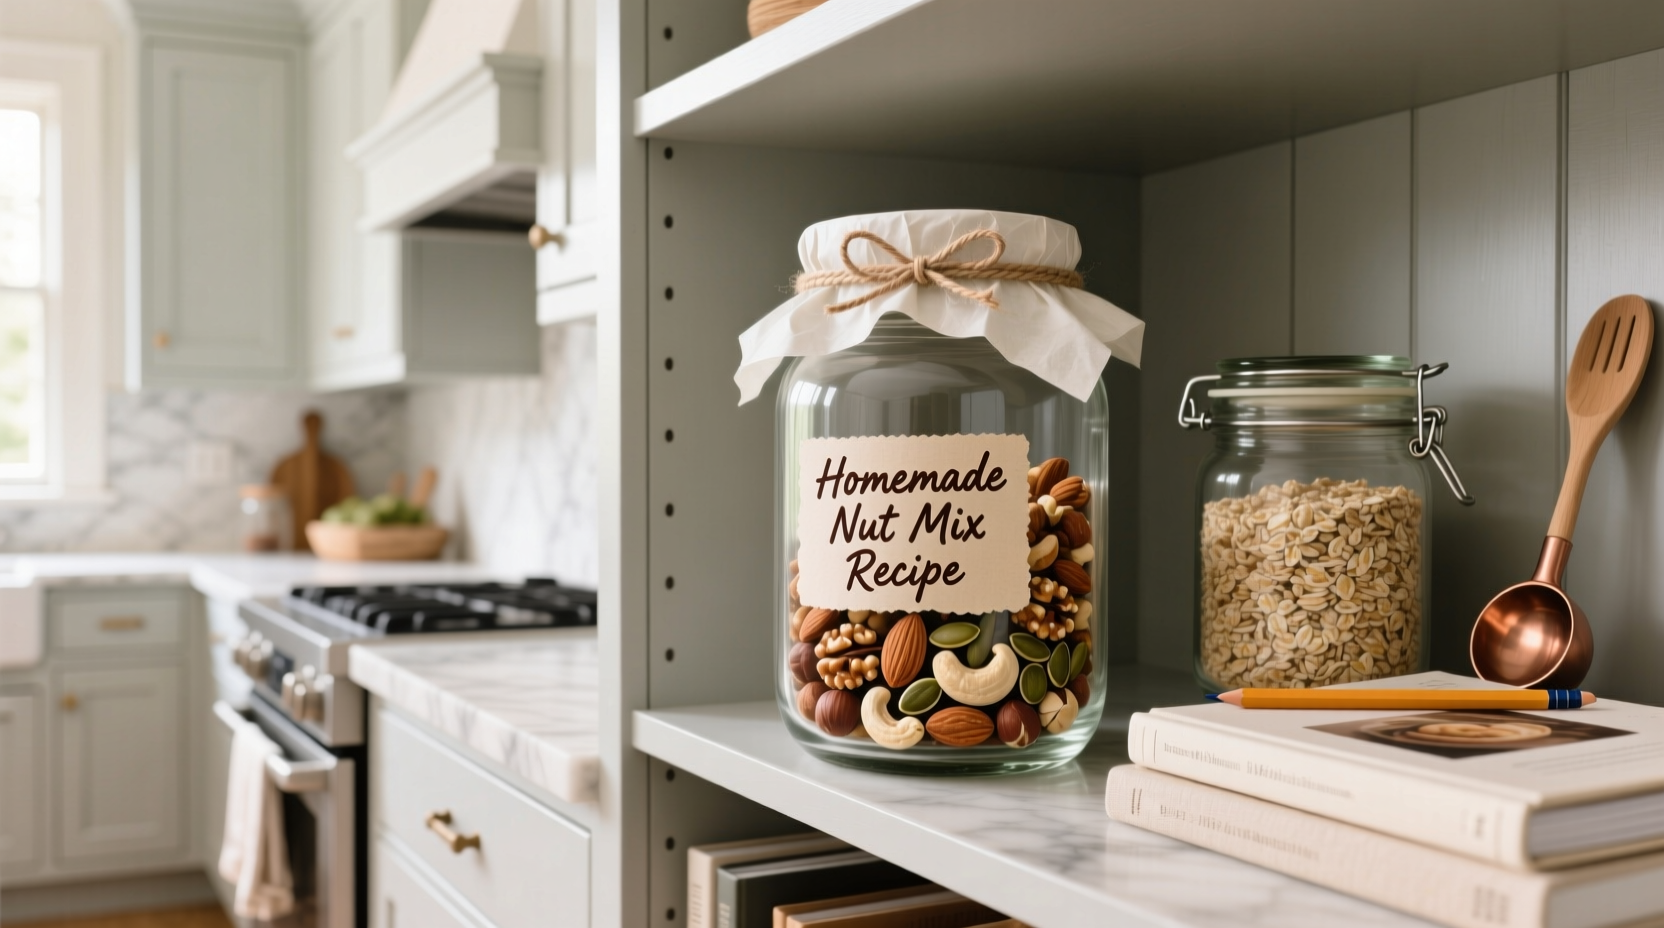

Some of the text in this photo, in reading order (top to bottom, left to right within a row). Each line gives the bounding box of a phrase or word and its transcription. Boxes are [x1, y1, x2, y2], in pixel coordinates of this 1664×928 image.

[816, 450, 1007, 499] Homemade
[829, 502, 986, 545] Nut Mix
[846, 548, 966, 603] Recipe
